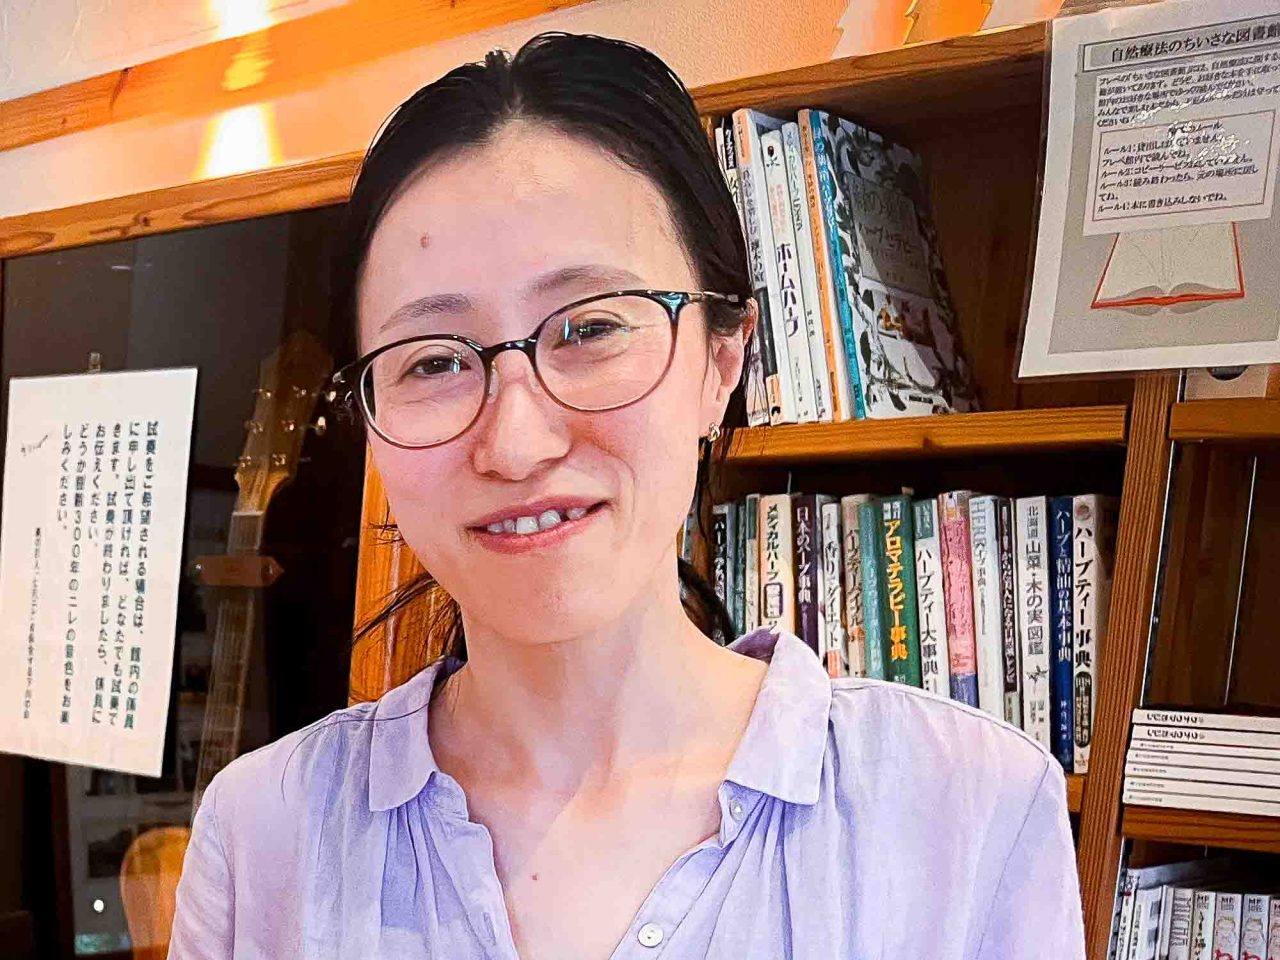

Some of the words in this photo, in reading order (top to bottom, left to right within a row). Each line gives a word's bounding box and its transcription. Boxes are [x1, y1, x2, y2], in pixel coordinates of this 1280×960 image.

[776, 243, 799, 338] ホームハーブ
[884, 520, 908, 661] アロマテラピー事典
[917, 549, 937, 675] ハーブティー大事典
[1025, 541, 1045, 655] 山菜・木の実図鑑
[1074, 527, 1093, 669] ハーブティー事典
